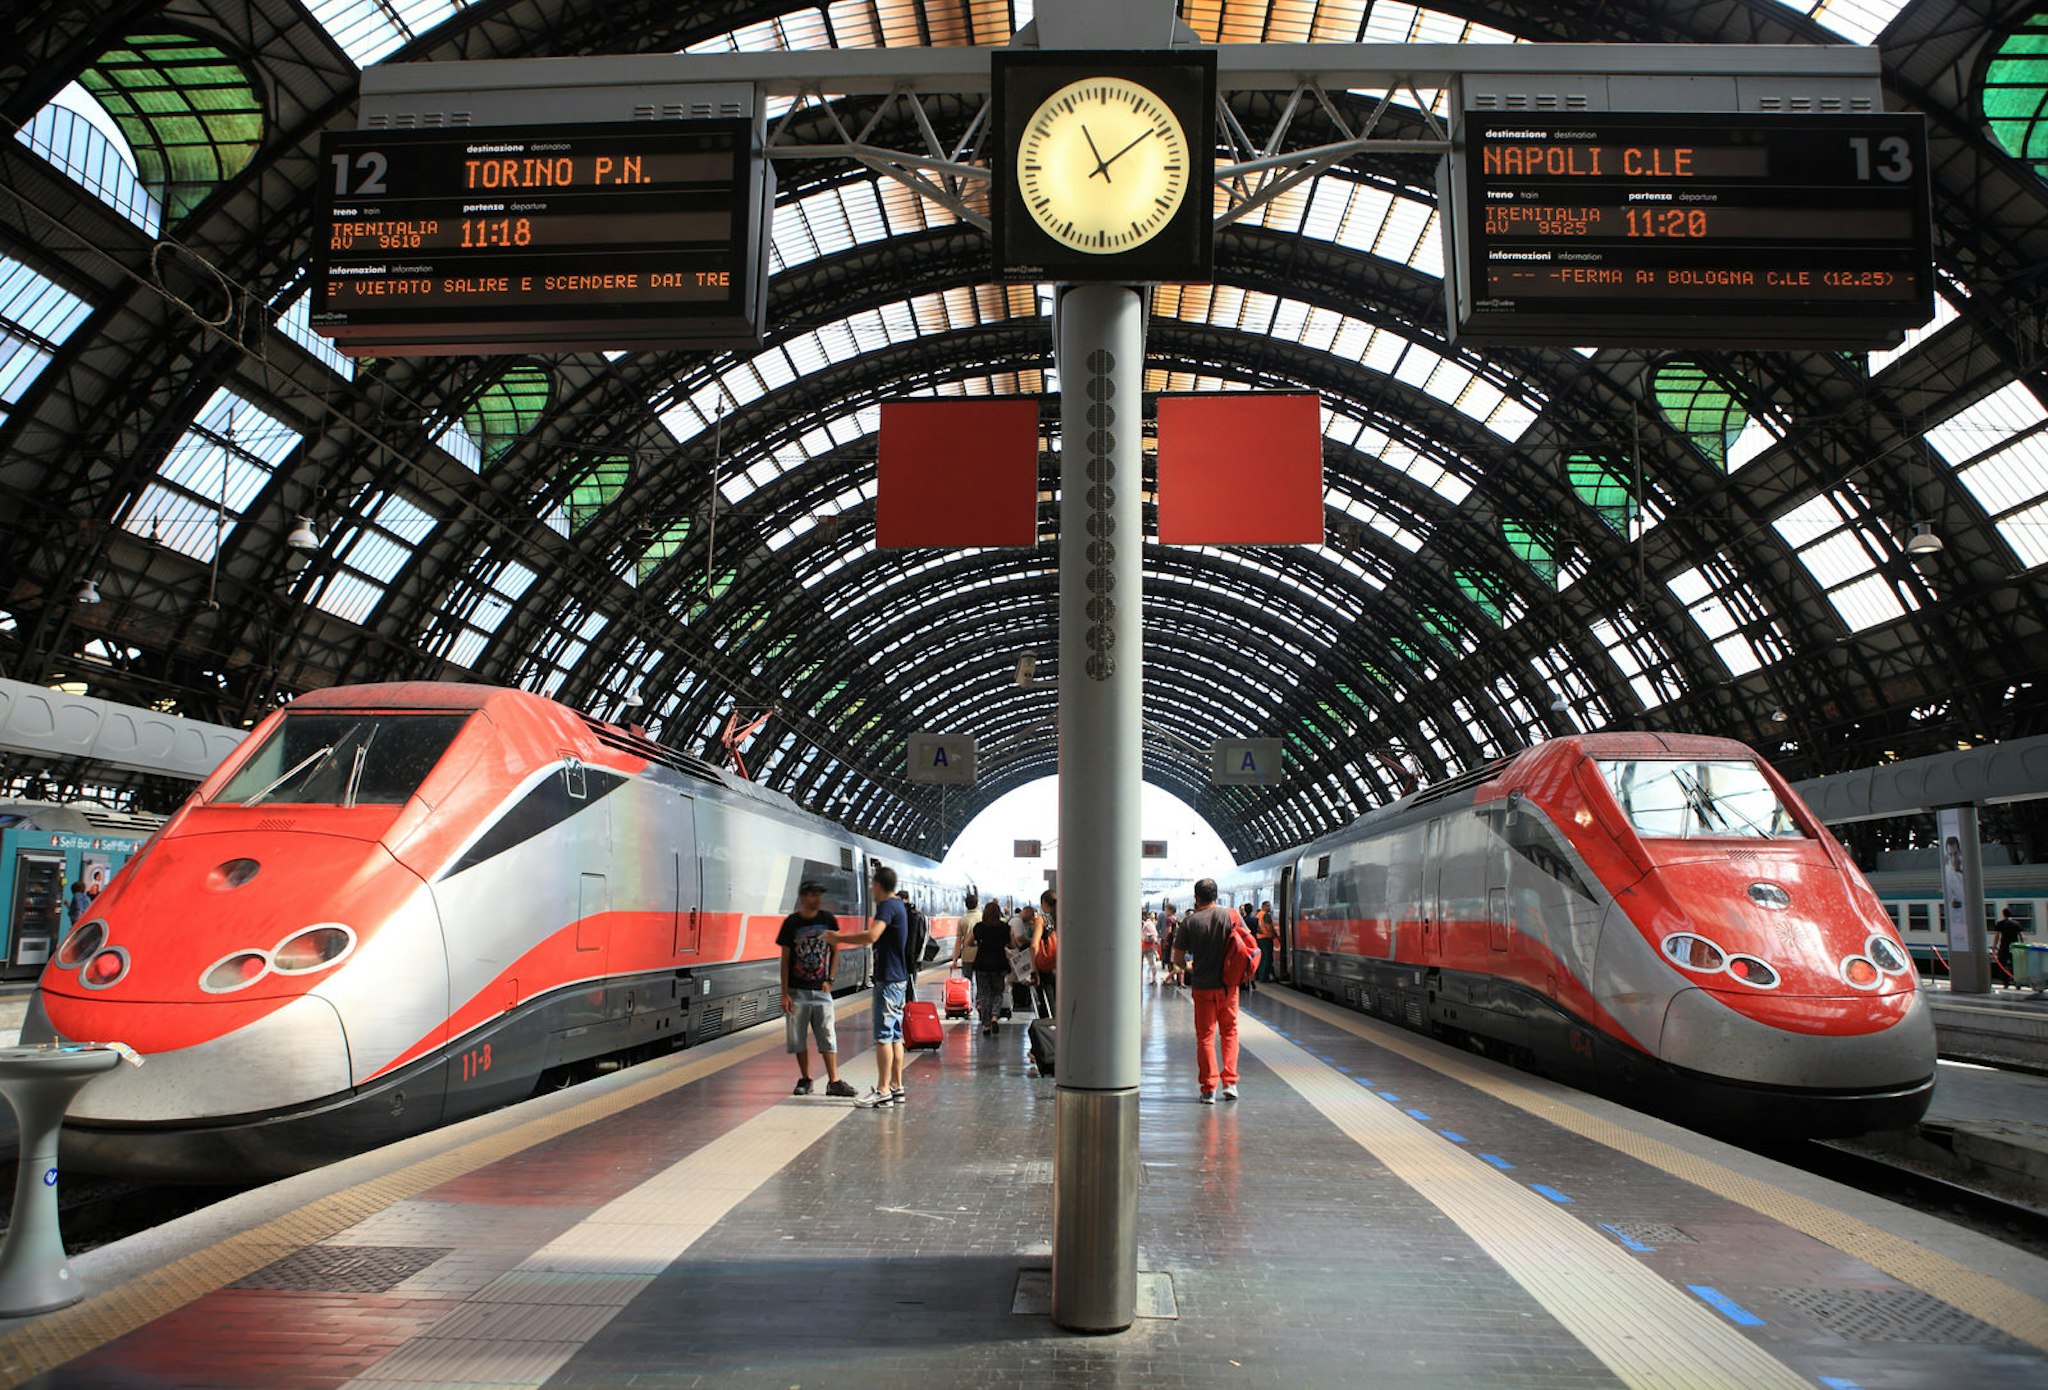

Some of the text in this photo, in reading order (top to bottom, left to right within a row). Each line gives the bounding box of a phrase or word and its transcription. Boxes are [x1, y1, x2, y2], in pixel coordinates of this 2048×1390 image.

[1485, 129, 1547, 139] destinazione
[1483, 146, 1694, 176] NAPOLI C.LE
[1848, 136, 1914, 182] 13
[331, 151, 388, 195] 12
[465, 155, 651, 189] TORINO P.N.
[1487, 190, 1514, 199] treno
[1628, 192, 1673, 201] partenza
[333, 208, 358, 216] treno
[1485, 206, 1601, 222] TRENITALIA
[332, 220, 438, 237] TRENITALIA
[1485, 221, 1588, 235] AV 9525
[1626, 209, 1708, 238] 11:20
[461, 218, 531, 247] 11:18
[331, 235, 421, 250] AV 9610
[1489, 250, 1551, 260] informazioni
[355, 280, 432, 295] VIETATO
[444, 277, 509, 292] SALIRE
[521, 277, 532, 291] E
[544, 274, 639, 291] SCENDERE
[651, 273, 682, 288] DAI
[696, 272, 731, 286] TRE
[1636, 270, 1655, 285] A:
[1668, 271, 1754, 286] BOLOGNA
[1767, 271, 1810, 286] C.LE
[1823, 272, 1895, 287] (12.25)
[933, 747, 949, 767] A
[1241, 751, 1256, 771] A
[77, 838, 91, 849] Bar
